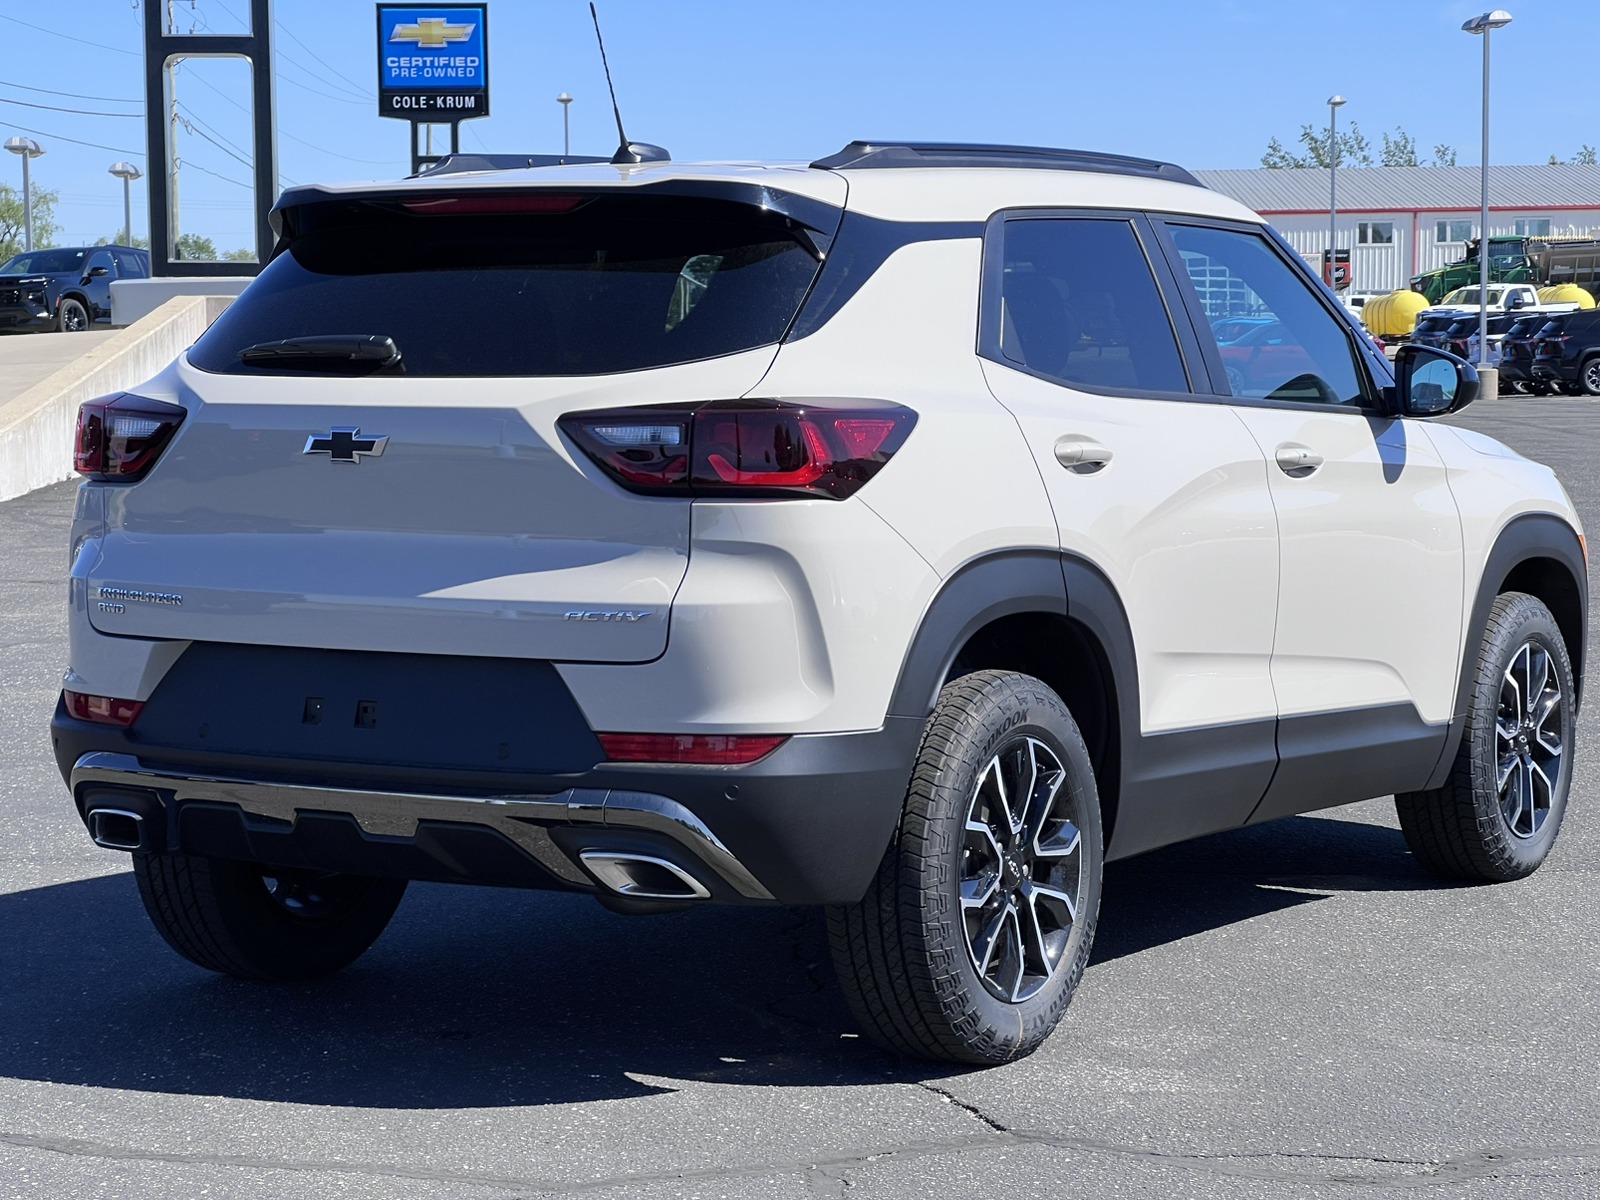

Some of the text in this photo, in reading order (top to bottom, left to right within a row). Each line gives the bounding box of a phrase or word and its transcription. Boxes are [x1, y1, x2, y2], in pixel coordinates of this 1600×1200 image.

[386, 56, 480, 67] CERTIFIED
[391, 67, 475, 78] PRE-OWNED
[97, 586, 182, 606] TRAILBLAZER
[98, 602, 125, 614] AWD
[563, 610, 652, 623] ACTIV
